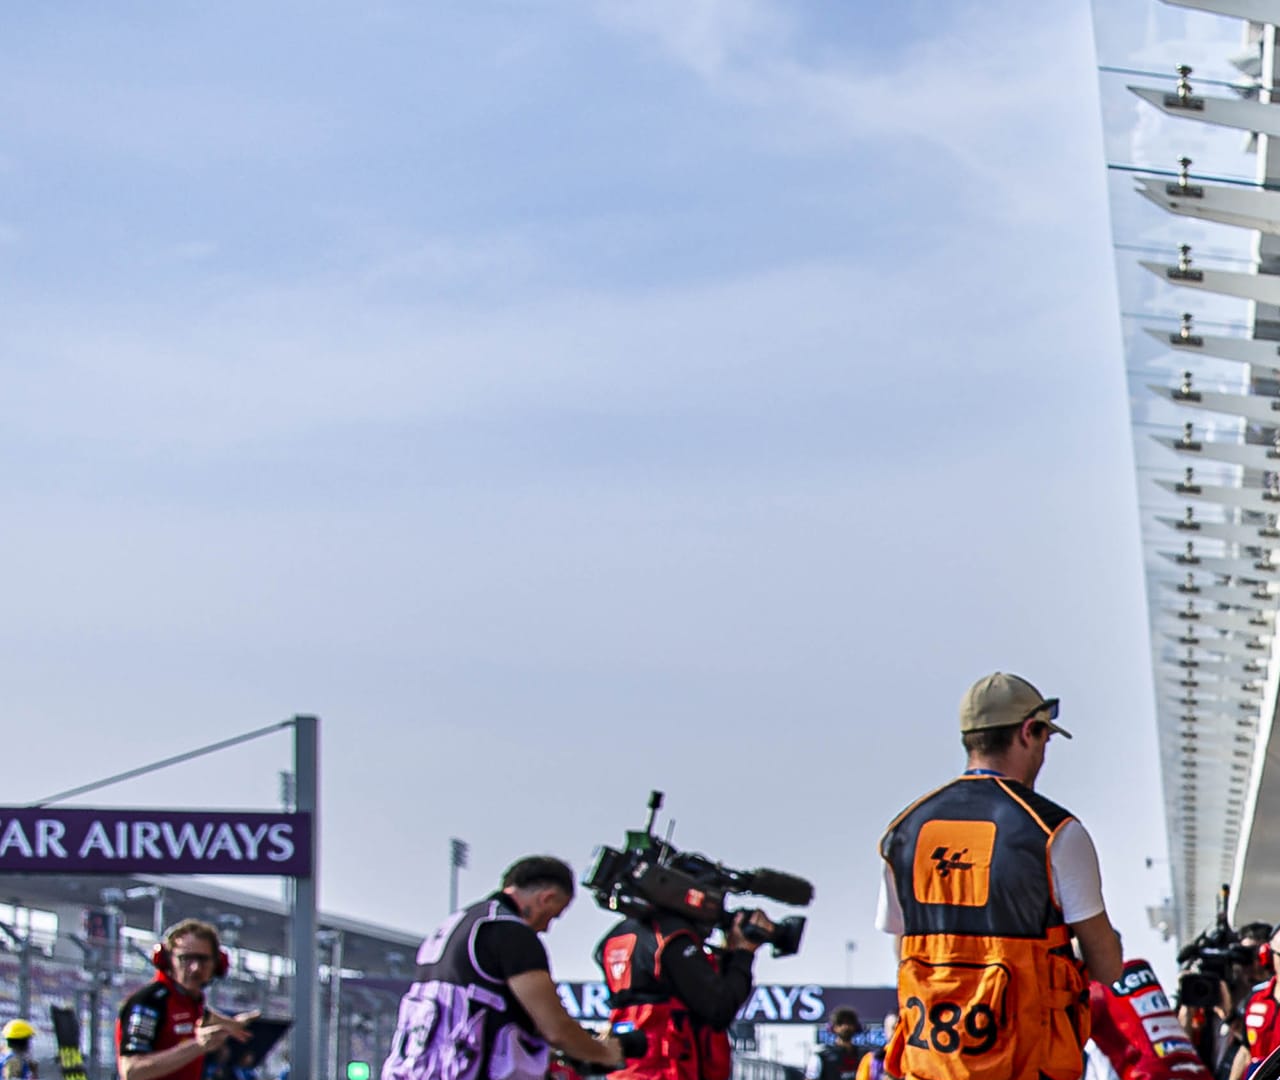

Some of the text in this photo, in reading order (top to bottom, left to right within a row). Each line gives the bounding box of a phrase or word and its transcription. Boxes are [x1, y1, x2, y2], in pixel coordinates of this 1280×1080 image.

[77, 821, 296, 861] AIRWAYS
[1112, 968, 1154, 994] Len
[904, 994, 998, 1056] 289
